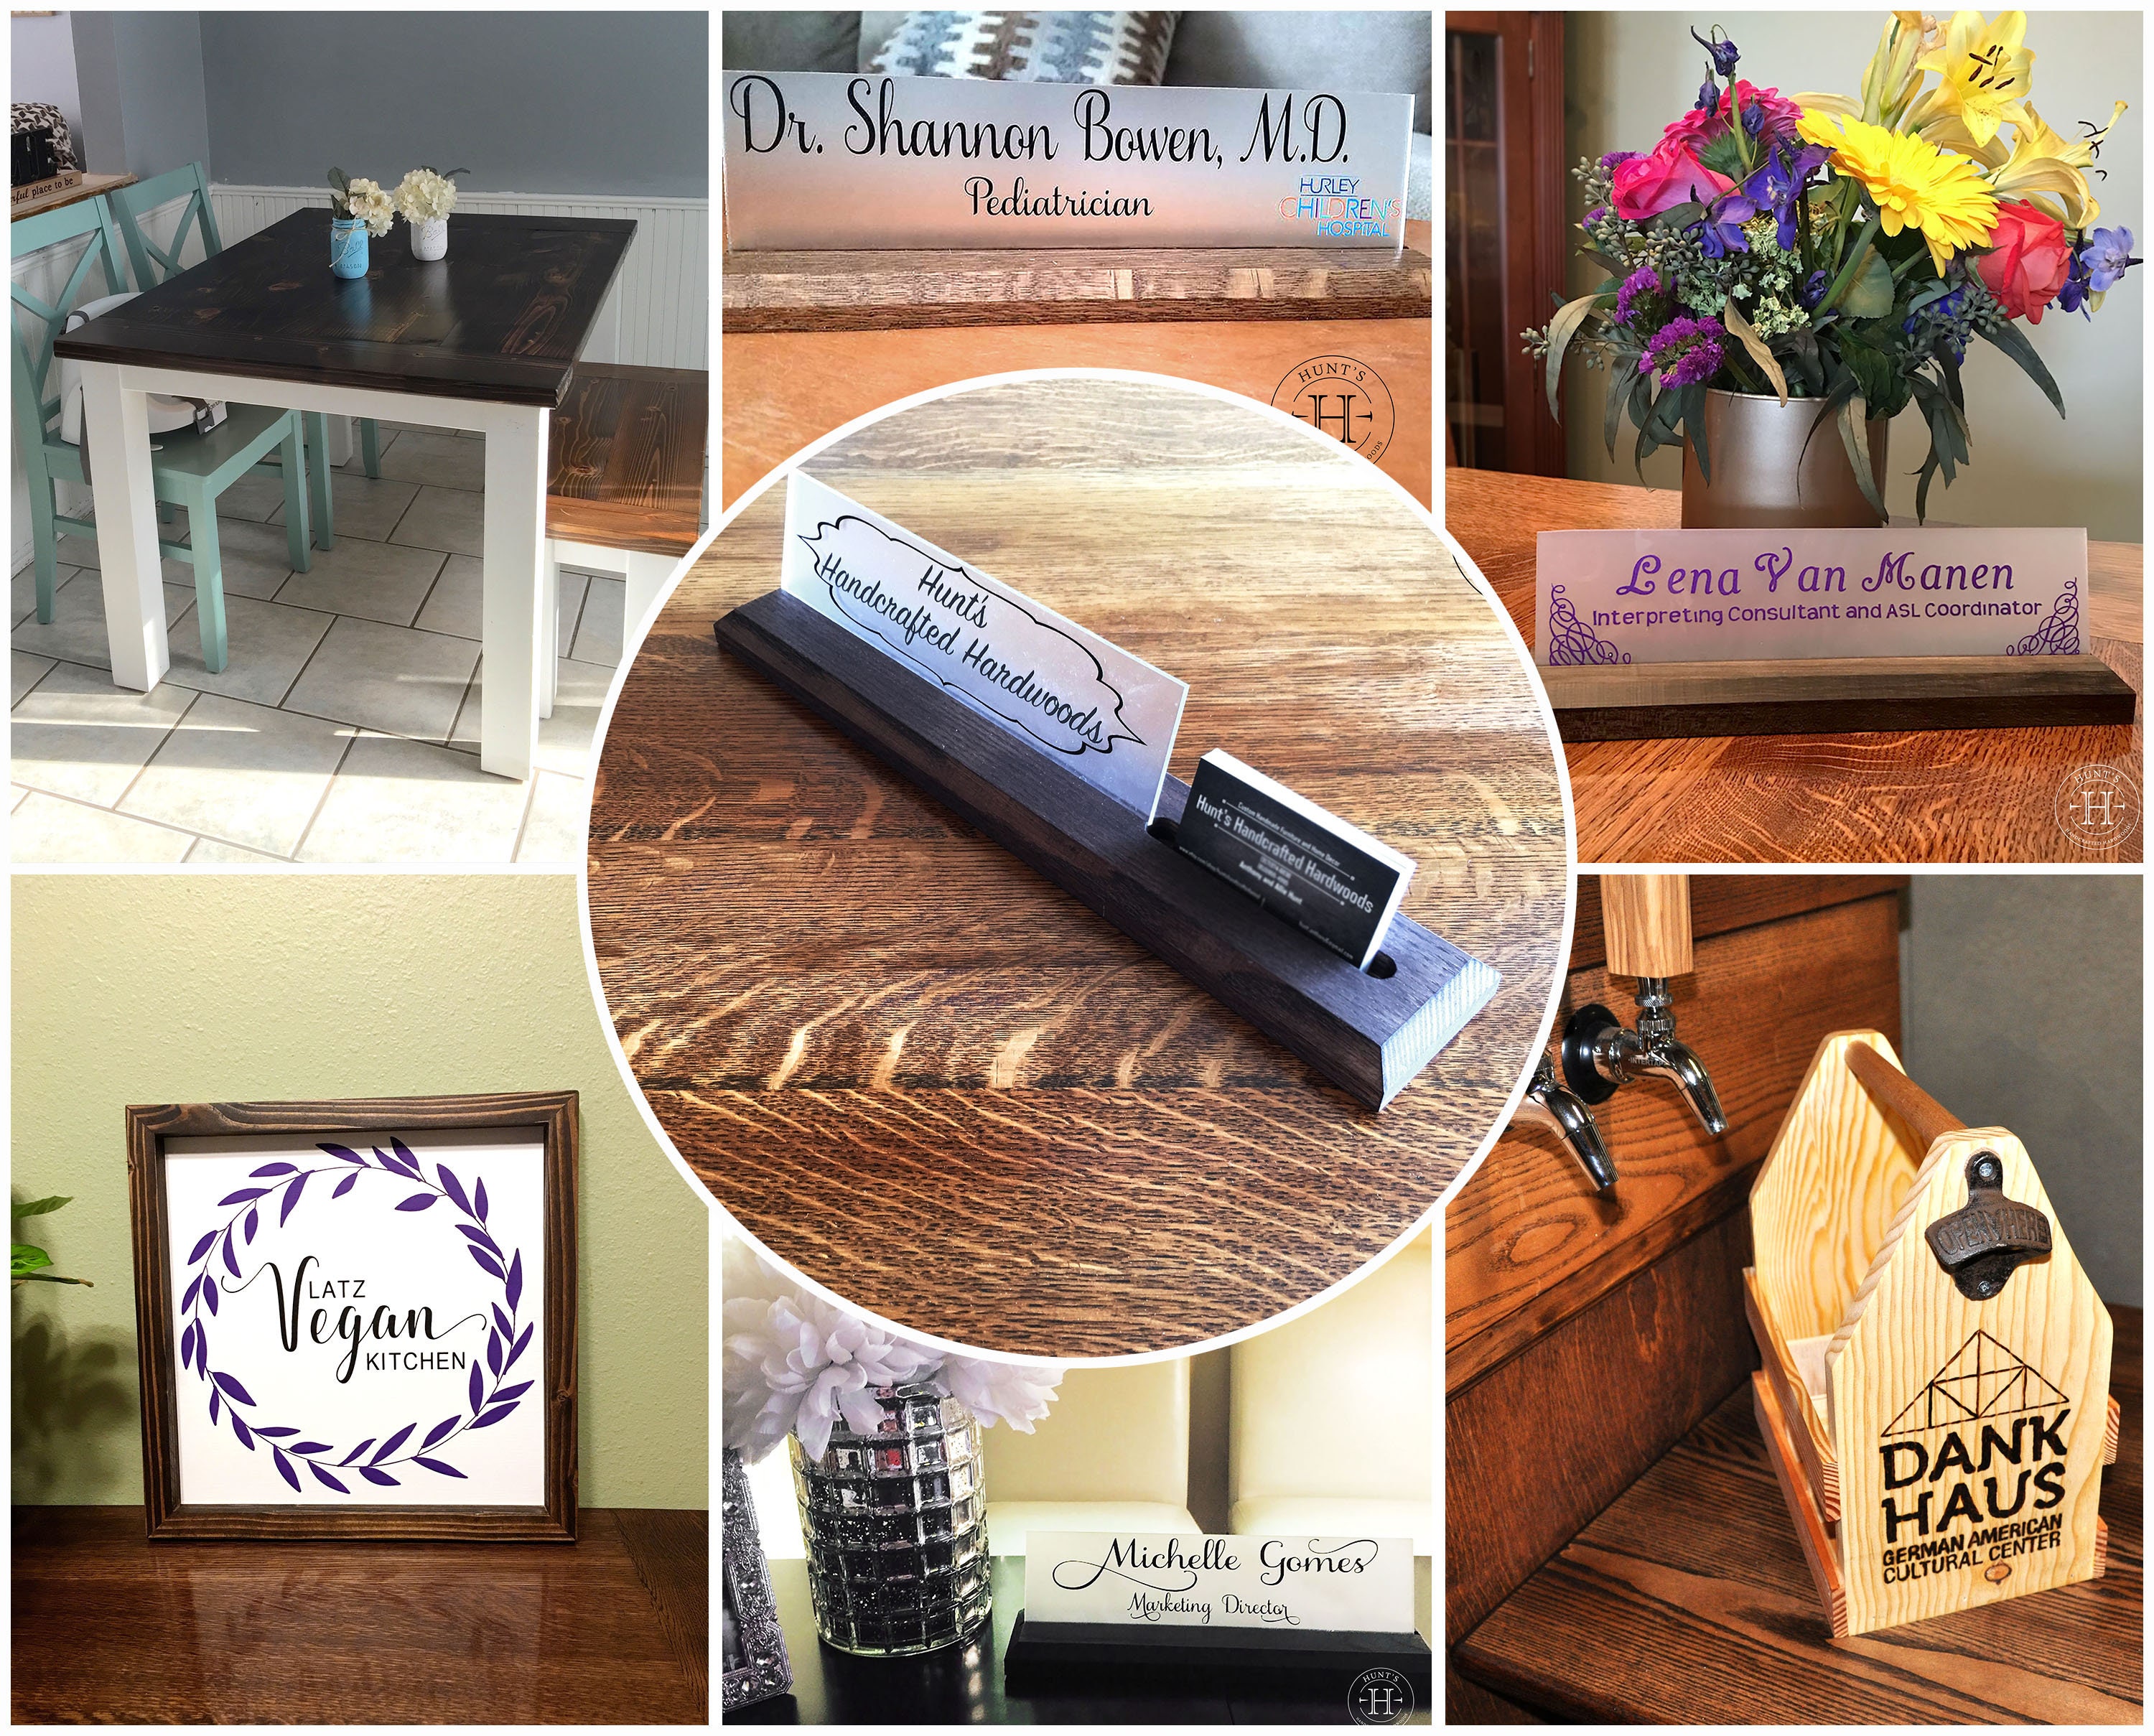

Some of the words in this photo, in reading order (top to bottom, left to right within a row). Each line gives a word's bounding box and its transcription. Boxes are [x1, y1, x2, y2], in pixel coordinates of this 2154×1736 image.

[730, 75, 824, 154] Dr.
[844, 77, 1059, 161] Shannon
[1073, 88, 1223, 169] Bowen,
[1239, 92, 1350, 164] M.D.
[32, 184, 52, 199] place
[55, 181, 62, 190] to
[64, 177, 73, 186] be
[964, 176, 1155, 217] Pediatrician
[1279, 196, 1402, 220] CHILDREN'S
[1300, 177, 1360, 194] HURLEY
[1317, 220, 1391, 237] HOSPITAL
[1616, 554, 1742, 596] Lena
[1754, 546, 1847, 593] Van
[1861, 551, 2015, 592] Manen
[918, 564, 988, 629] Hunt's
[1593, 607, 1723, 627] Interpreting
[1728, 604, 1841, 622] Consultant
[1845, 604, 1882, 620] and
[1885, 603, 1921, 619] ASL
[1924, 601, 2043, 618] Coordinator
[821, 553, 961, 655] Handcrafted
[962, 638, 1104, 745] Hardwoods
[1195, 794, 1231, 827] Hunt's
[1233, 818, 1307, 872] Handcrafted
[1305, 858, 1374, 914] Hardwoods
[1630, 1057, 1664, 1067] INTERTAP
[309, 1280, 366, 1299] LATZ
[220, 1256, 488, 1384] Vegan
[366, 1352, 466, 1371] KITCHEN
[1879, 1409, 2071, 1491] DANK
[1881, 1462, 2066, 1544] HAUS
[1052, 1537, 1241, 1592] Michelle
[1259, 1538, 1379, 1586] Gomes
[1883, 1534, 1965, 1567] GERMAN
[1967, 1513, 2063, 1549] AMERICAN
[1883, 1549, 1984, 1585] CULTURAL
[1988, 1531, 2061, 1562] CENTER
[1127, 1591, 1213, 1625] Marketing
[1221, 1594, 1302, 1625] Director
